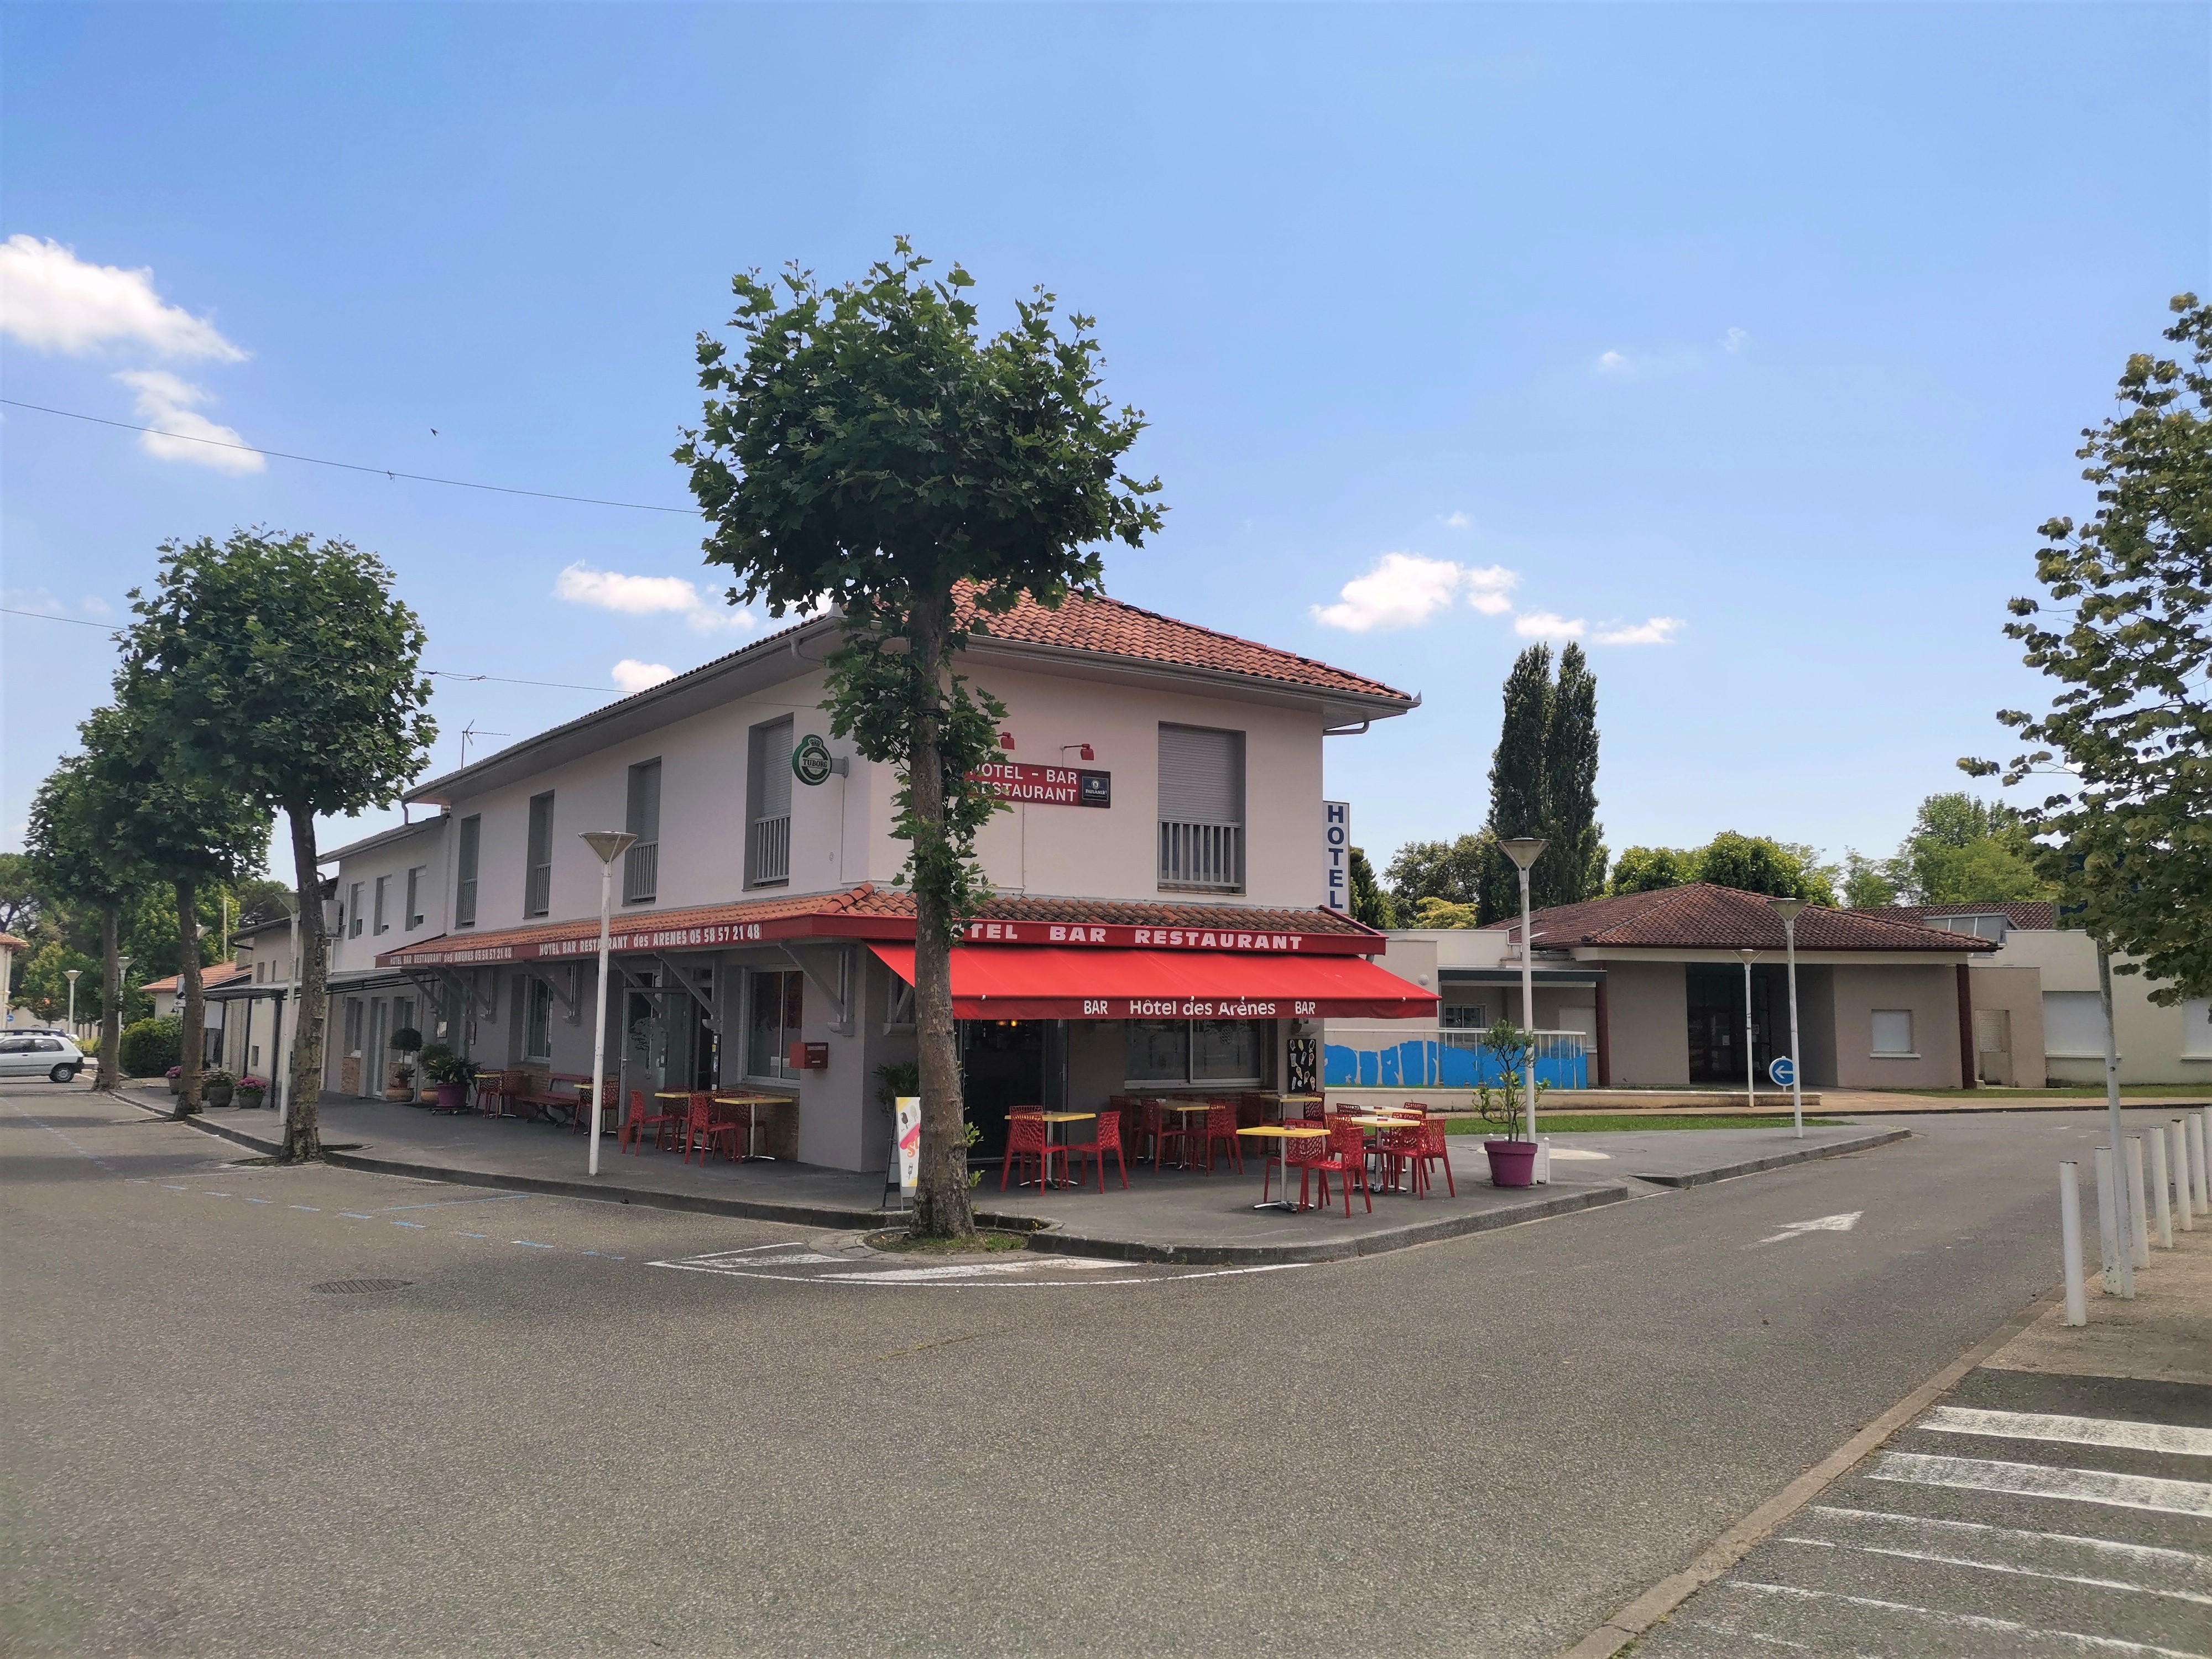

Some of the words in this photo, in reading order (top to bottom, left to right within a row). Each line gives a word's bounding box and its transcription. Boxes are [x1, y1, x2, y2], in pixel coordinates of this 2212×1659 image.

[803, 759, 827, 768] TUBORG
[1046, 769, 1077, 785] BAR
[970, 780, 1076, 802] ESTAURANT
[1327, 805, 1344, 909] HOTEL
[539, 943, 560, 956] HOTEL
[562, 941, 576, 953] BAR
[580, 936, 628, 952] RESTARANT
[633, 934, 649, 948] des
[653, 930, 687, 946] ARENES
[690, 929, 701, 944] 05
[704, 927, 715, 942] 58
[718, 926, 729, 941] 57
[733, 925, 744, 940] 21
[747, 924, 760, 939] 48
[950, 923, 1018, 939] TEL
[1050, 926, 1106, 942] BAR
[1135, 929, 1302, 950] RESTAURANT
[403, 954, 412, 964] BAR
[414, 953, 442, 964] RESTAURANT
[444, 952, 453, 963] des
[475, 950, 481, 961] 05
[489, 948, 495, 959] 57
[497, 947, 503, 959] 21
[504, 947, 512, 958] 48
[1083, 1000, 1108, 1015] BAR
[1129, 999, 1177, 1015] Hôtel
[1182, 1001, 1212, 1015] des
[1218, 1000, 1276, 1016] Arènes
[1294, 1000, 1316, 1015] BAR
